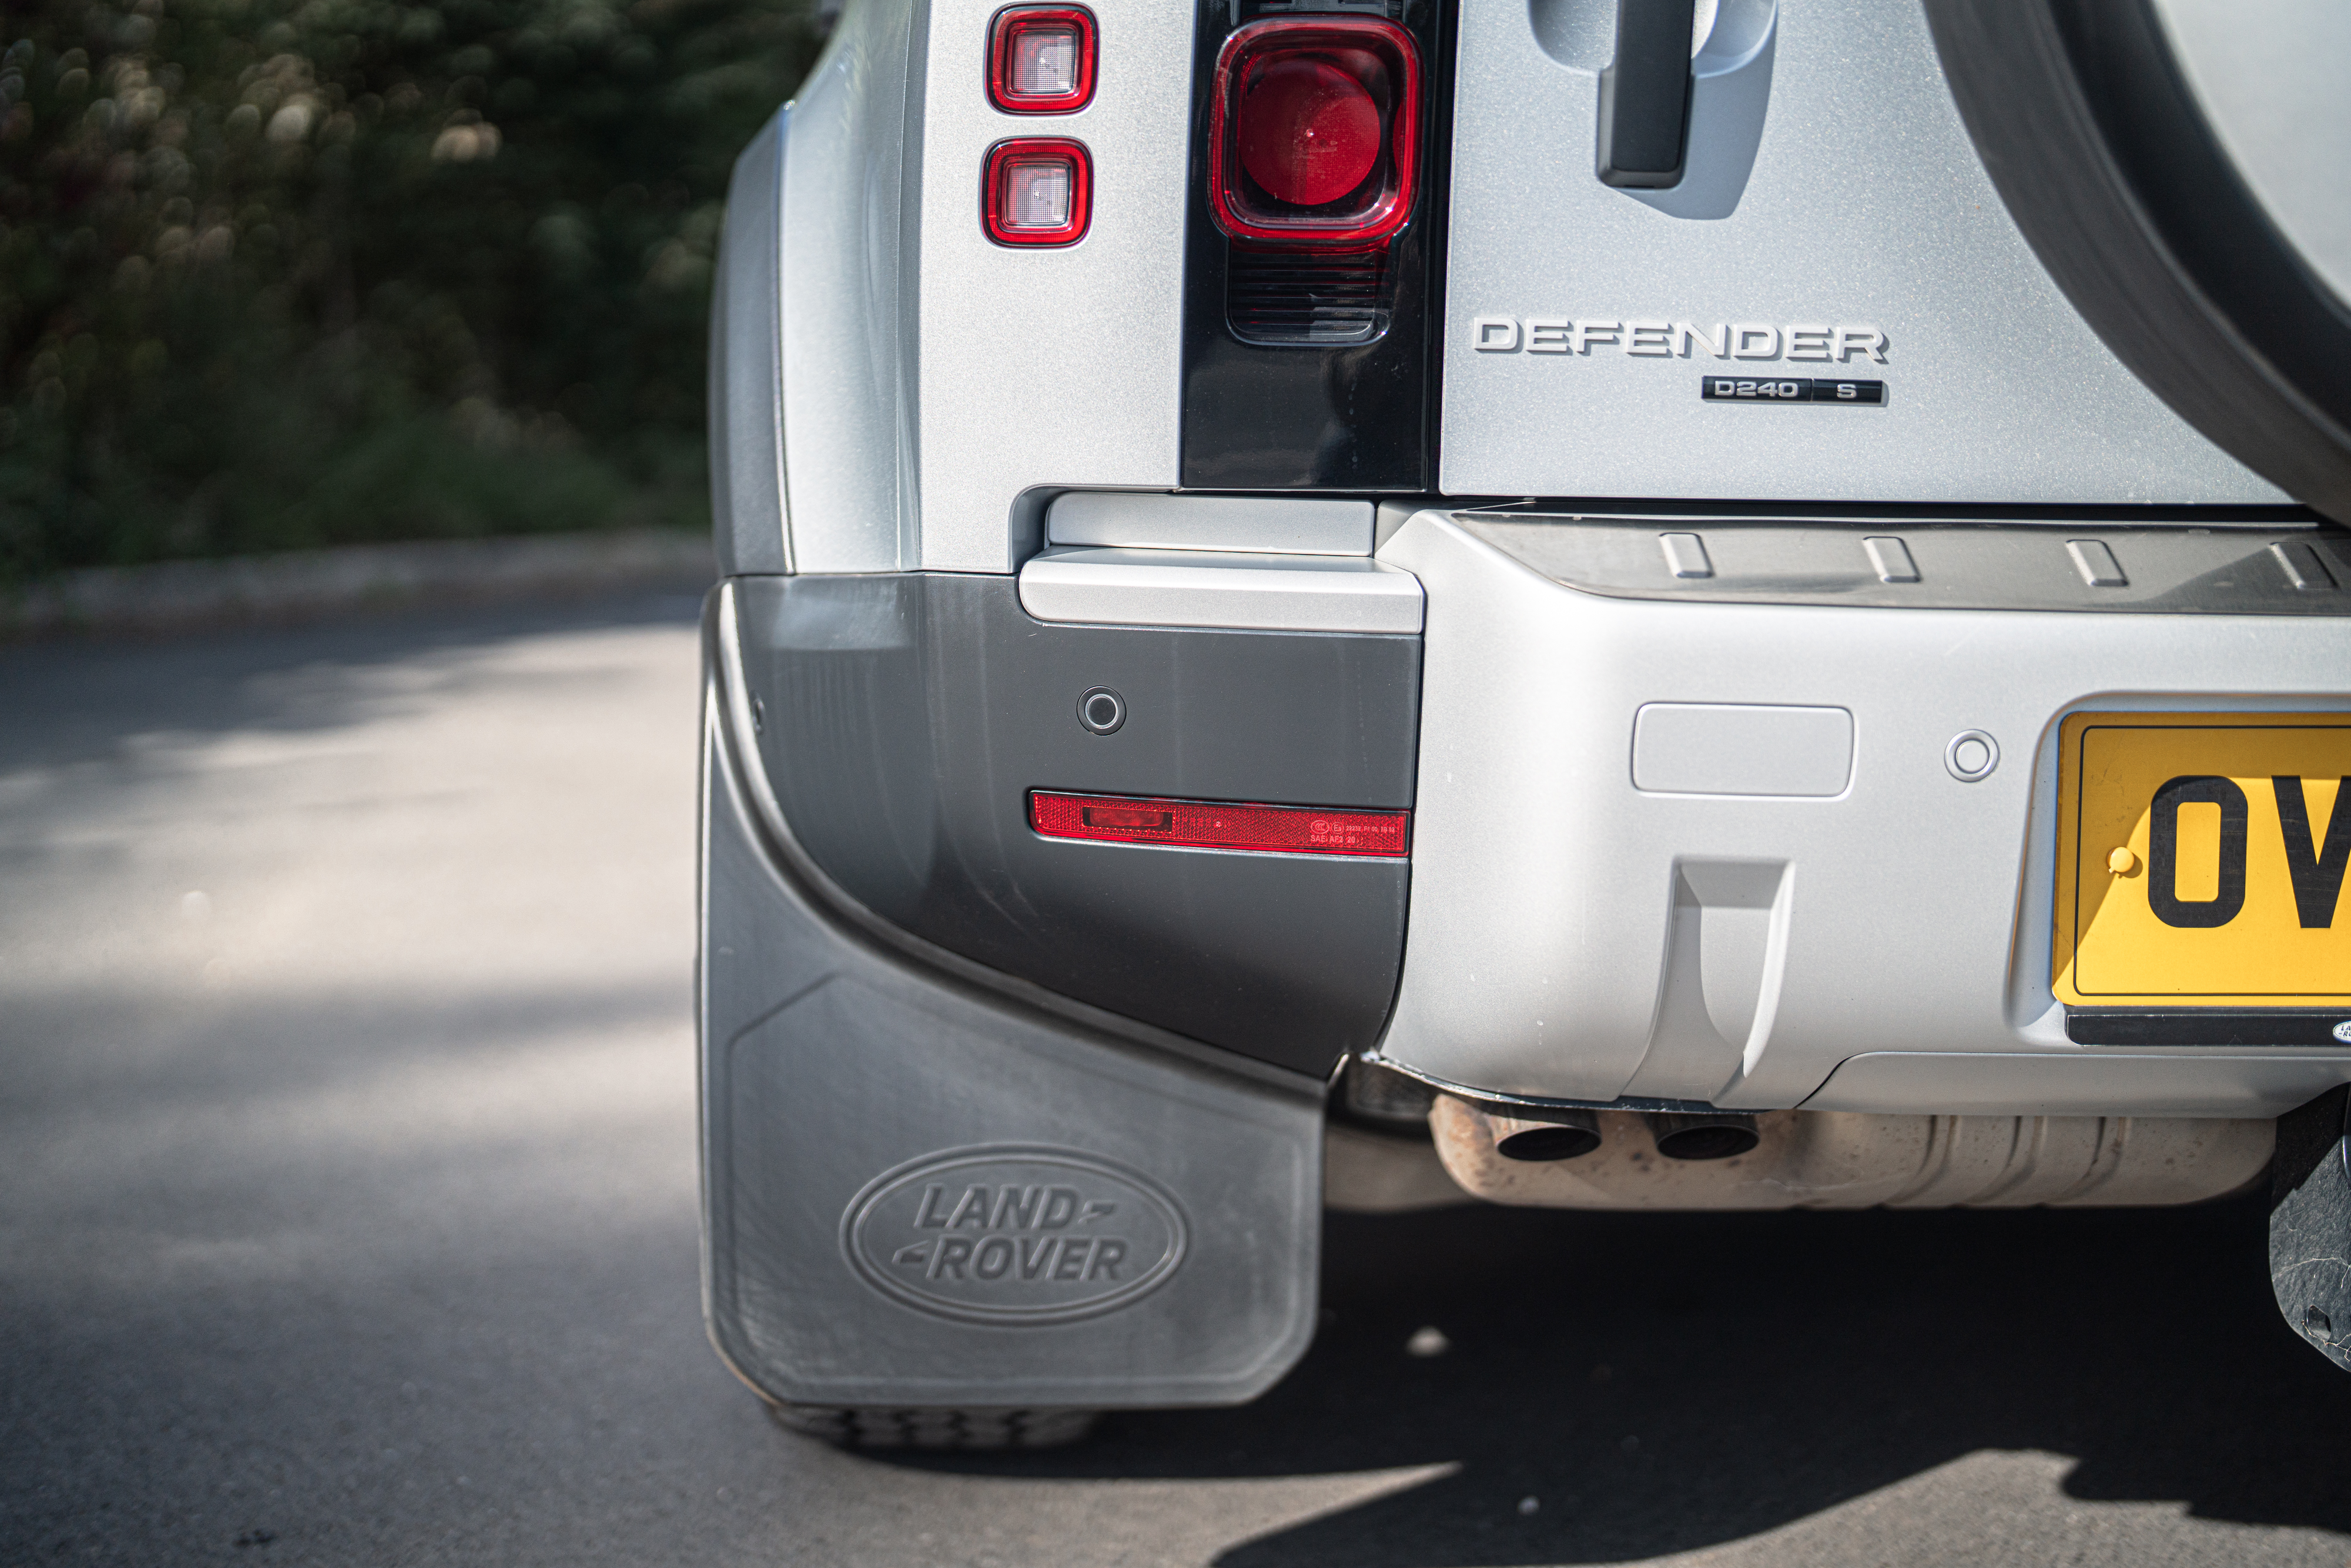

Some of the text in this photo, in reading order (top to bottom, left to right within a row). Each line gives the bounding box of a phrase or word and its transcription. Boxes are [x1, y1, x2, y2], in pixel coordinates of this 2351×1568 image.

[1473, 317, 1886, 360] DEFENDER
[1714, 380, 1857, 399] D240 S
[2148, 775, 2351, 929] OV
